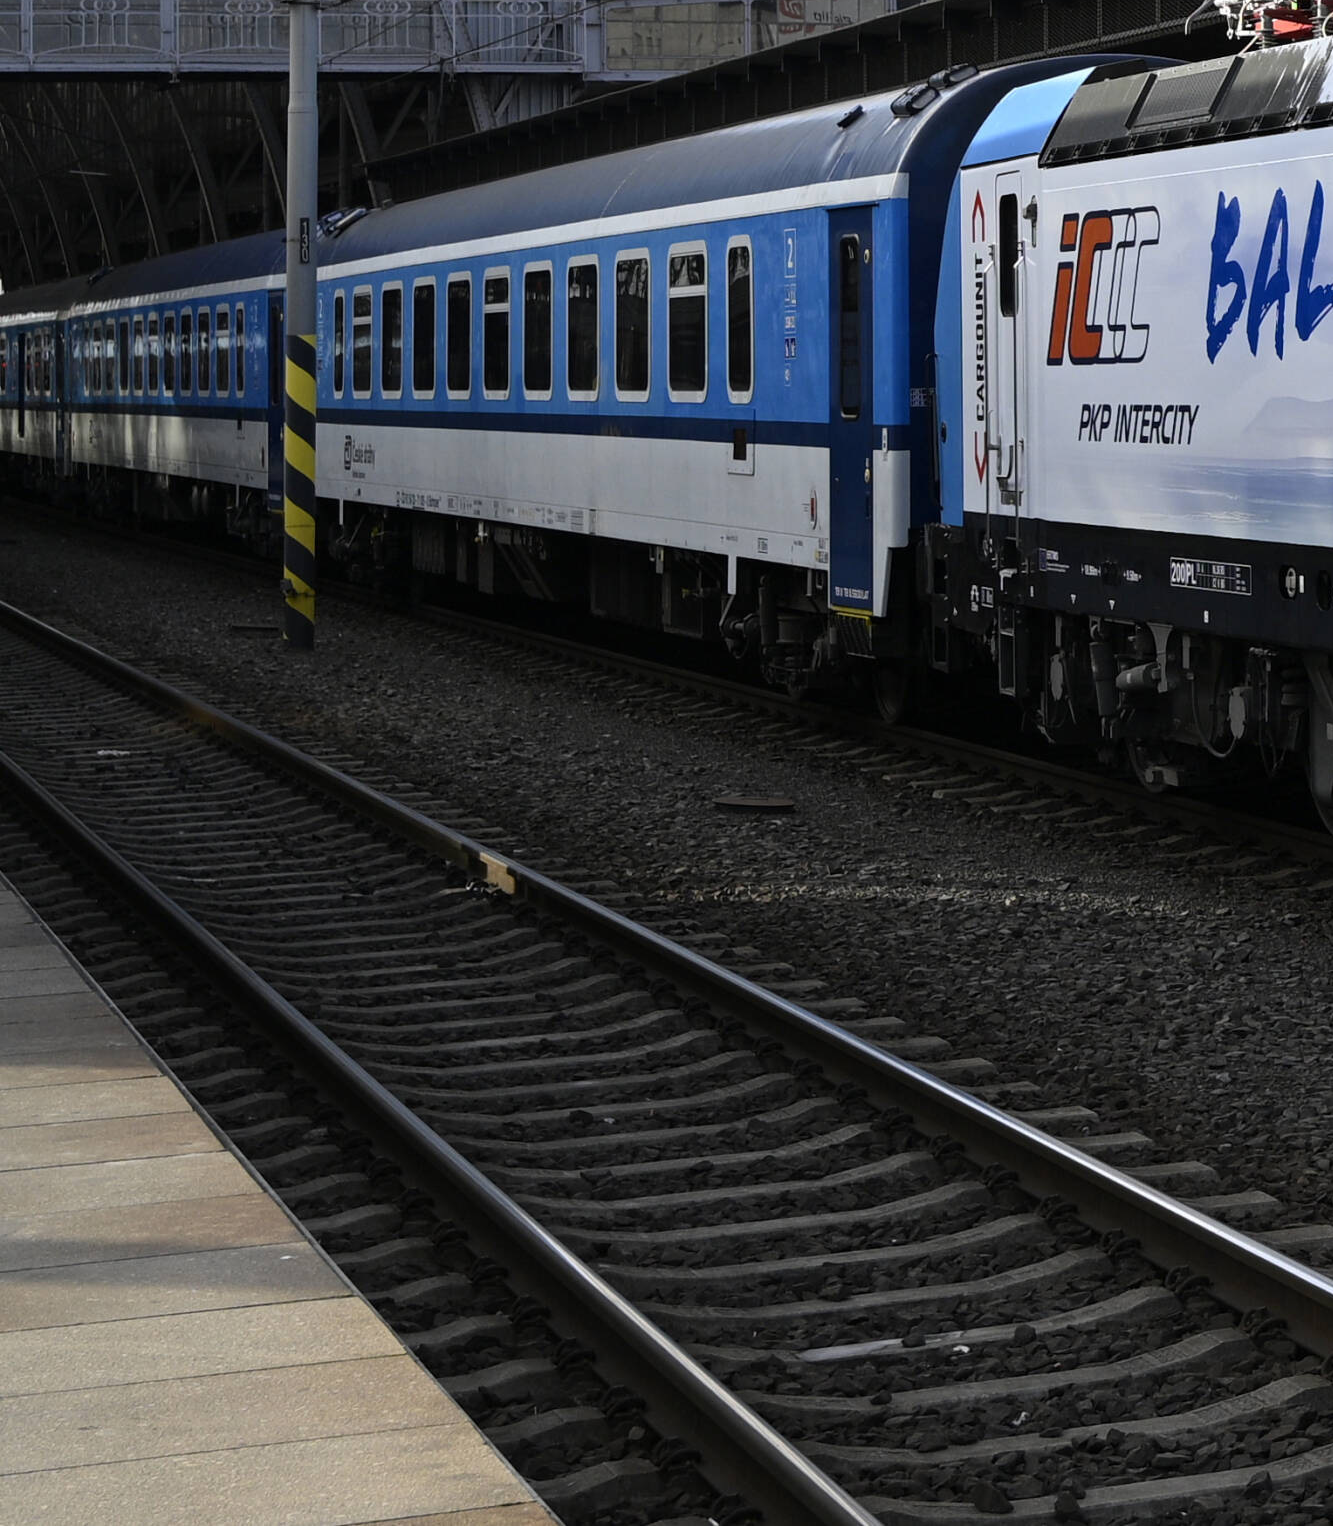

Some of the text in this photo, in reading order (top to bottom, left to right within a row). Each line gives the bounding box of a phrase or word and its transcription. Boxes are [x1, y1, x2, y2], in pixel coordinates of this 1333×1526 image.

[301, 221, 309, 262] 130
[787, 237, 794, 268] 2
[975, 252, 985, 422] CARGOUNIT
[1078, 404, 1200, 445] PKP INTERCITY
[1171, 562, 1186, 584] 200
[1186, 563, 1197, 585] PL
